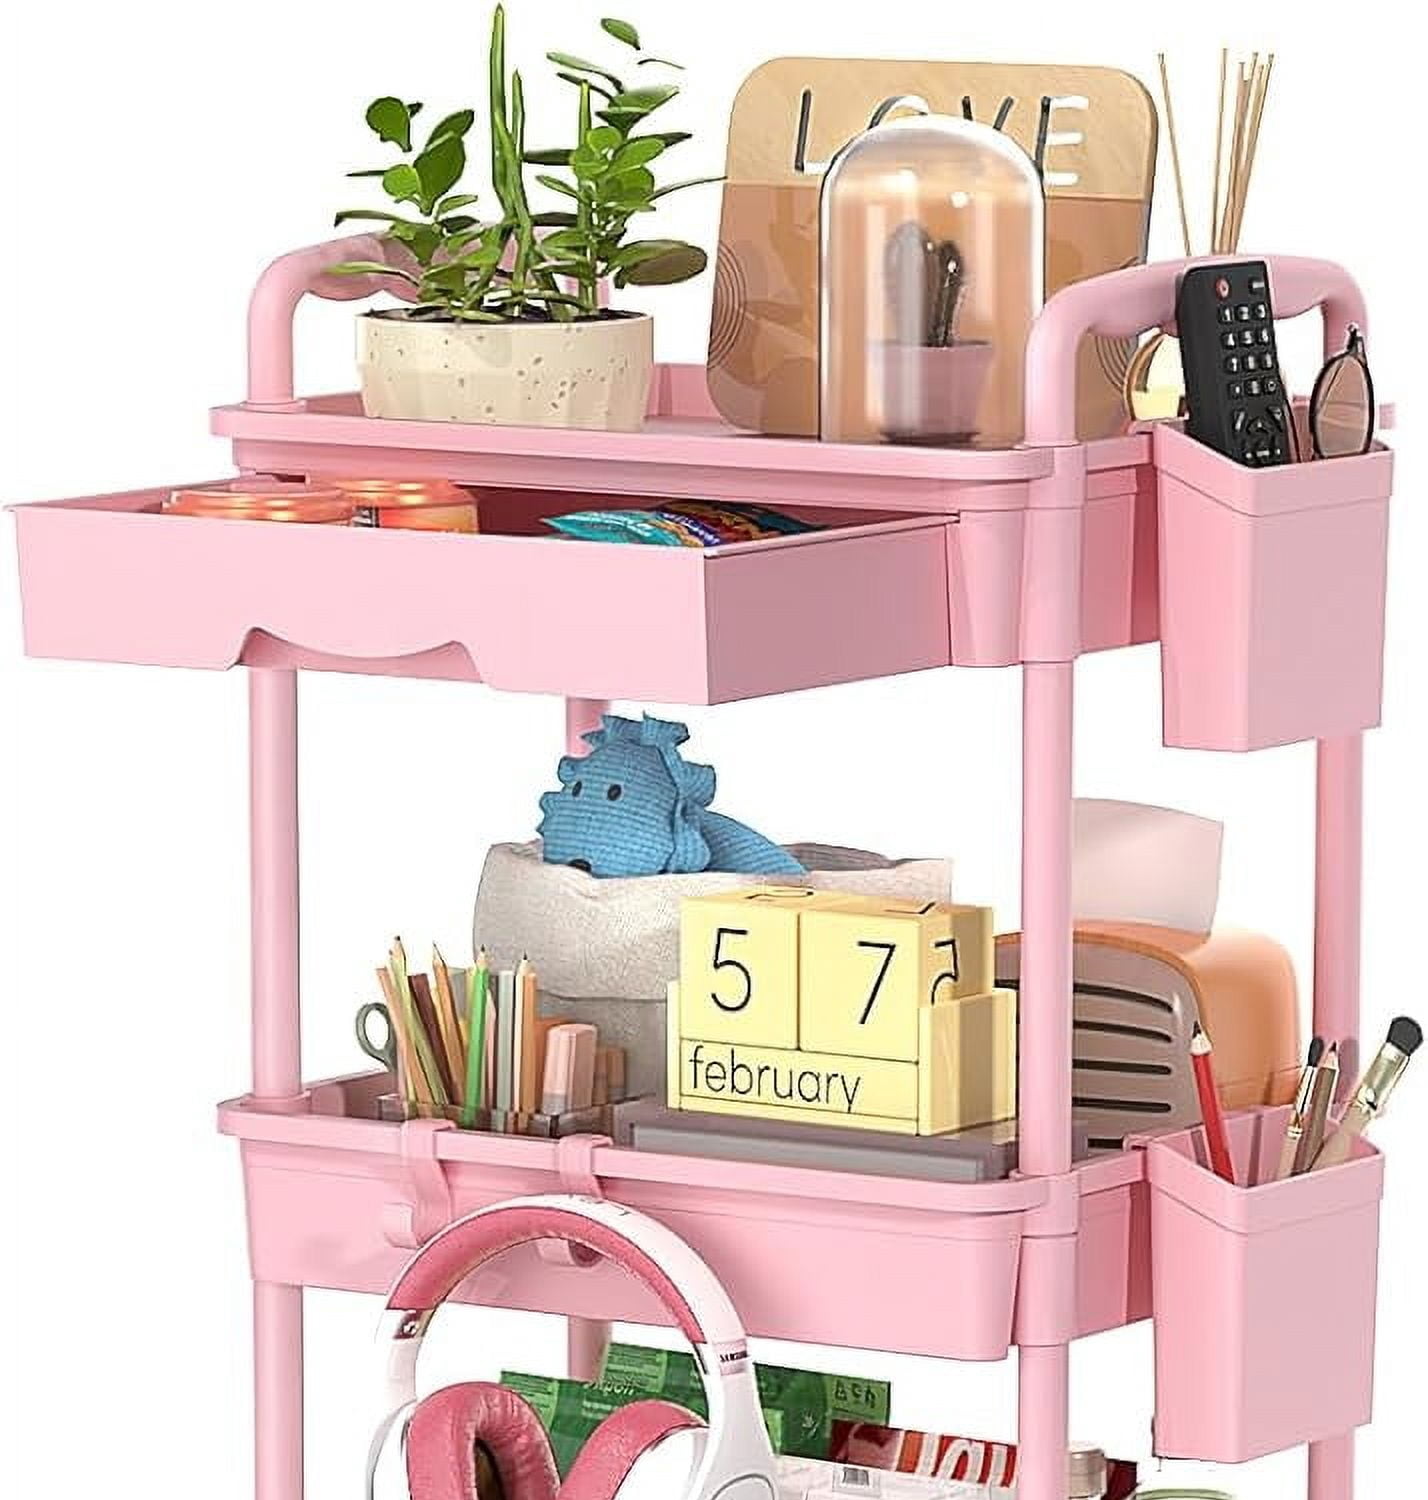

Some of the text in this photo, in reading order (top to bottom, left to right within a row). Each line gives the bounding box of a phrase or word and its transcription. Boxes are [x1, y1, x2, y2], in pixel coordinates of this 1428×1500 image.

[711, 927, 897, 1025] 5 7
[689, 1045, 862, 1114] february
